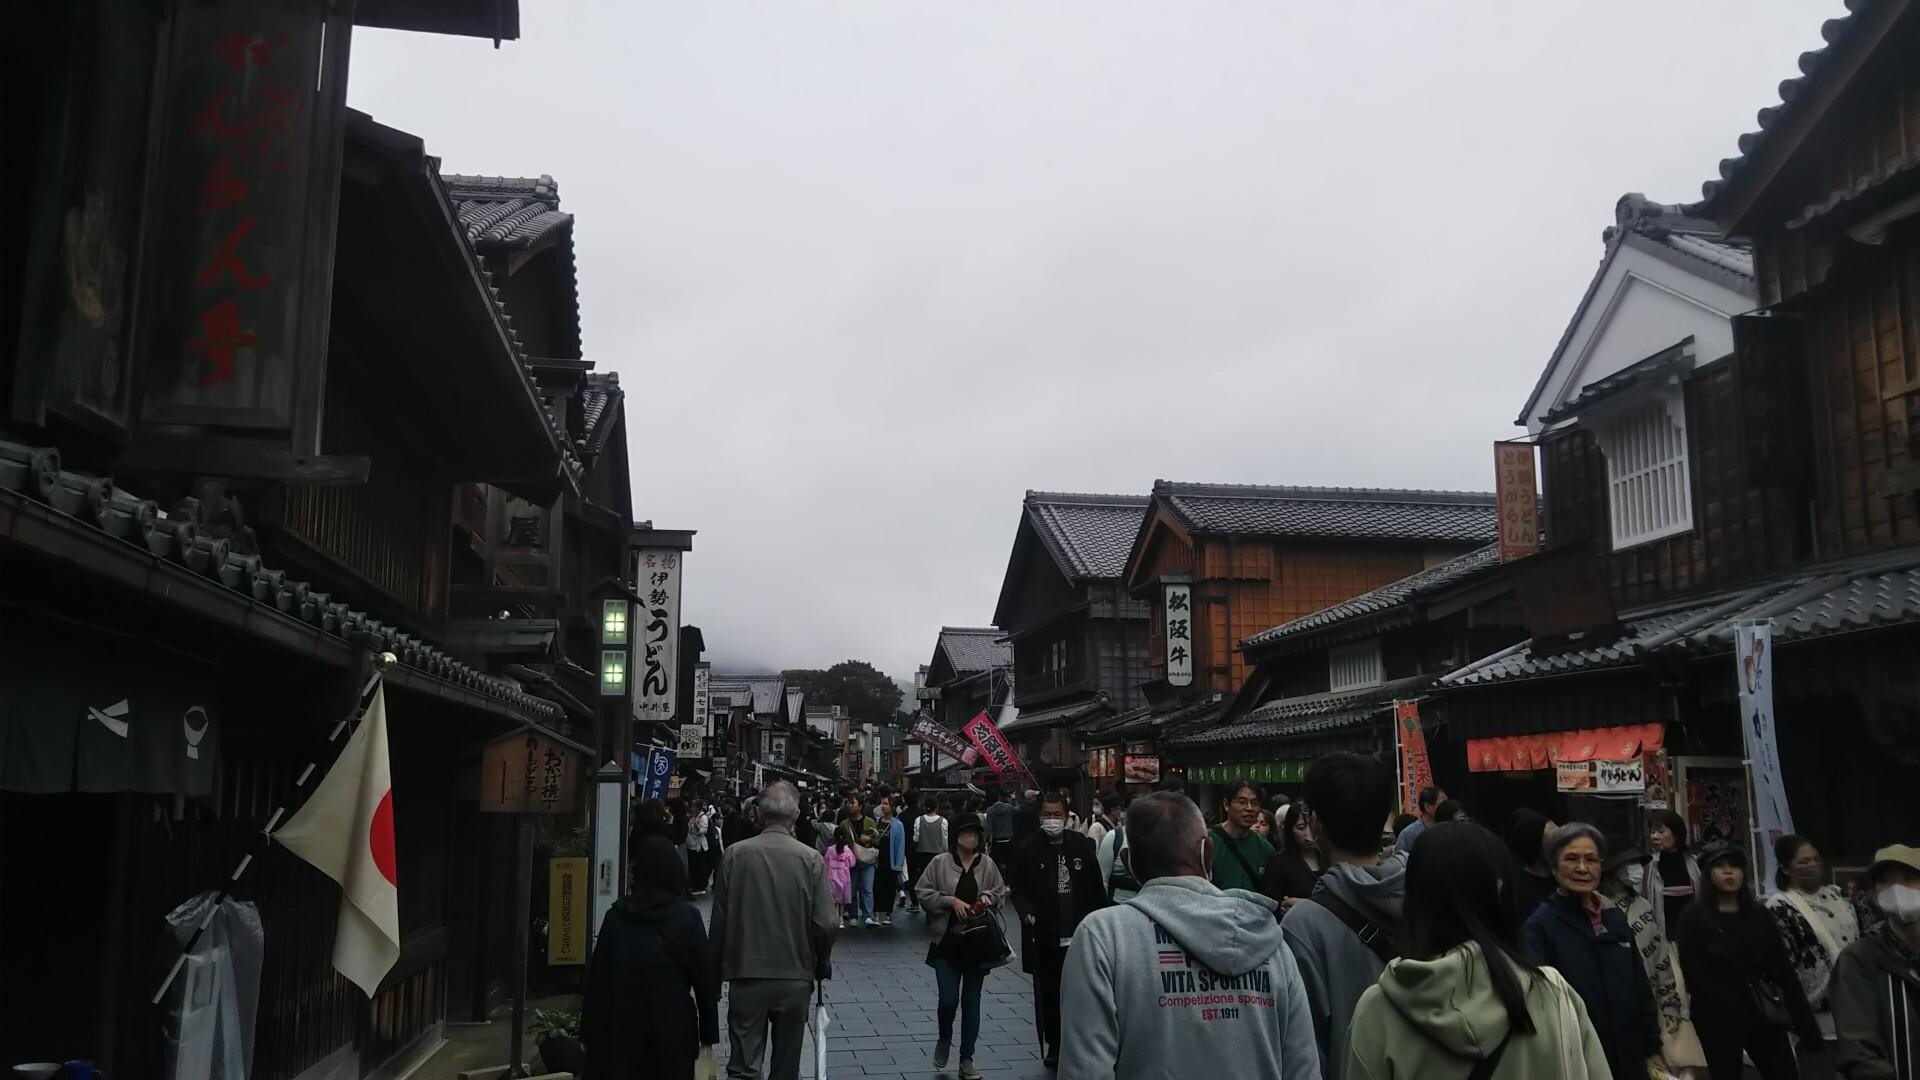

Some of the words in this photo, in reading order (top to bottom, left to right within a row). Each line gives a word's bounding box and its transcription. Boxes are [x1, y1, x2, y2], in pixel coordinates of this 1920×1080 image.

[1502, 449, 1519, 544] とうがらし
[644, 553, 676, 570] 名物
[643, 572, 669, 697] 伊勢うどん
[1168, 591, 1190, 667] 松阪牛
[1158, 996, 1234, 1008] Competizione
[1161, 971, 1196, 993] VITA
